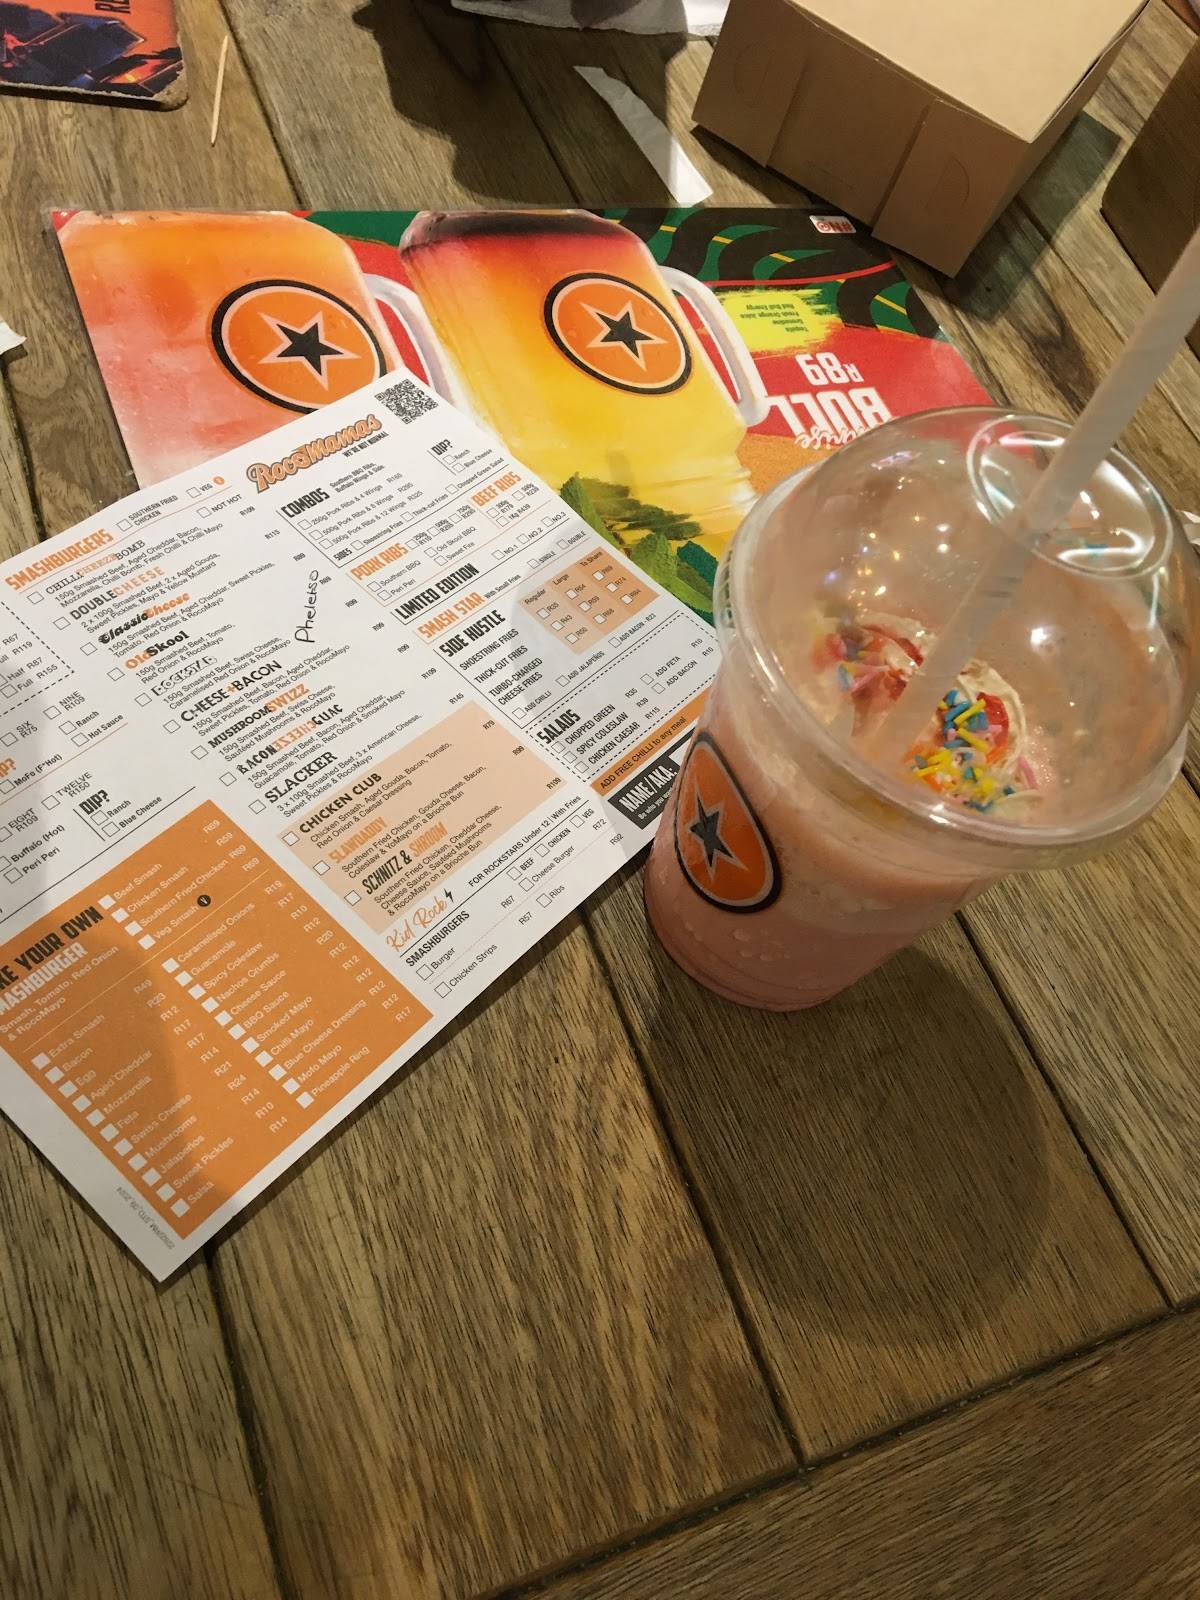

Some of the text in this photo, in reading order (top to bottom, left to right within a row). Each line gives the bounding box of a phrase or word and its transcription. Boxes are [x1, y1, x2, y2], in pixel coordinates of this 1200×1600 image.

[795, 352, 864, 386] R89
[431, 439, 453, 455] DIP?
[199, 483, 213, 492] VEG
[211, 493, 242, 512] NOT HOT
[281, 488, 330, 518] COMBOS
[471, 471, 521, 507] BEEF RIBS
[128, 495, 178, 521] SOUTHERN FRIED
[133, 510, 161, 526] CHICKEN
[6, 529, 113, 589] SMASHBURGERS
[333, 547, 352, 561] SIDES
[350, 543, 408, 580] PORK RIBS
[395, 563, 479, 619] LIMITED EDITION
[418, 592, 485, 638] SMASH STAR
[1, 633, 18, 646] R67
[11, 641, 33, 655] R119
[439, 610, 505, 657] SIDE HUSTLE
[459, 628, 519, 671] SHOESTRING FRIES
[6, 656, 42, 681] Half R87
[16, 663, 58, 691] Full R155
[474, 645, 528, 683] THICK-CUT FRIES
[488, 657, 542, 697] TURBO-CHARGED
[654, 656, 681, 677] ADD FETA
[59, 690, 81, 706] NINE
[63, 696, 85, 711] R109
[497, 671, 543, 705] CHEESE FRIES
[16, 720, 33, 733] SIX
[20, 725, 38, 738] R75
[75, 711, 99, 727] Ranch
[87, 714, 123, 739] Hot Sauce
[536, 709, 580, 744] SALADS
[564, 719, 595, 745] CHOPPED
[592, 703, 616, 723] GREEN
[576, 736, 597, 755] SPICY
[594, 711, 628, 740] COLESLAW
[588, 706, 660, 764] CHICKEN CAESAR R115
[253, 761, 297, 789] Guacamole,
[294, 743, 324, 761] Tomato,
[321, 732, 338, 744] Red
[336, 719, 357, 735] Onion
[361, 700, 388, 720] Smoked
[386, 690, 406, 703] Mayo
[600, 715, 687, 789] ADD FREE CHILLI to any meal
[13, 771, 36, 786] MoFo
[55, 771, 92, 796] TWELVE
[66, 780, 90, 797] R150
[265, 751, 337, 803] SLACKER
[619, 765, 679, 812] NAME/AKA:
[7, 807, 35, 829] EIGHT
[79, 789, 110, 815] DIP?
[106, 800, 131, 818] Ranch
[118, 796, 162, 828] Blue Cheese
[299, 773, 382, 833] CHICKEN CLUB
[581, 808, 594, 819] VEG
[13, 815, 38, 832] R109
[329, 817, 387, 863] SLAWDADDY
[547, 827, 571, 848] CHICKEN
[10, 824, 65, 862] Buffalo (Hot)
[468, 795, 581, 887] FOR ROCKSTARS Under 12 With Fries
[531, 818, 607, 882] Cheese Burger R72
[22, 846, 60, 874] Peri Peri
[361, 822, 447, 895] SCHNITZ & SHROOM
[519, 857, 534, 871] BEEF
[548, 833, 624, 899] Ribs R92
[14, 932, 65, 970] YOUR
[60, 906, 103, 939] OWN
[386, 896, 447, 952] Kid Rock
[405, 910, 470, 966] SMASHBURGERS
[430, 895, 515, 970] Burger R67
[449, 911, 532, 987] Chicken Strips R57
[0, 941, 88, 1015] MASHBURGER
